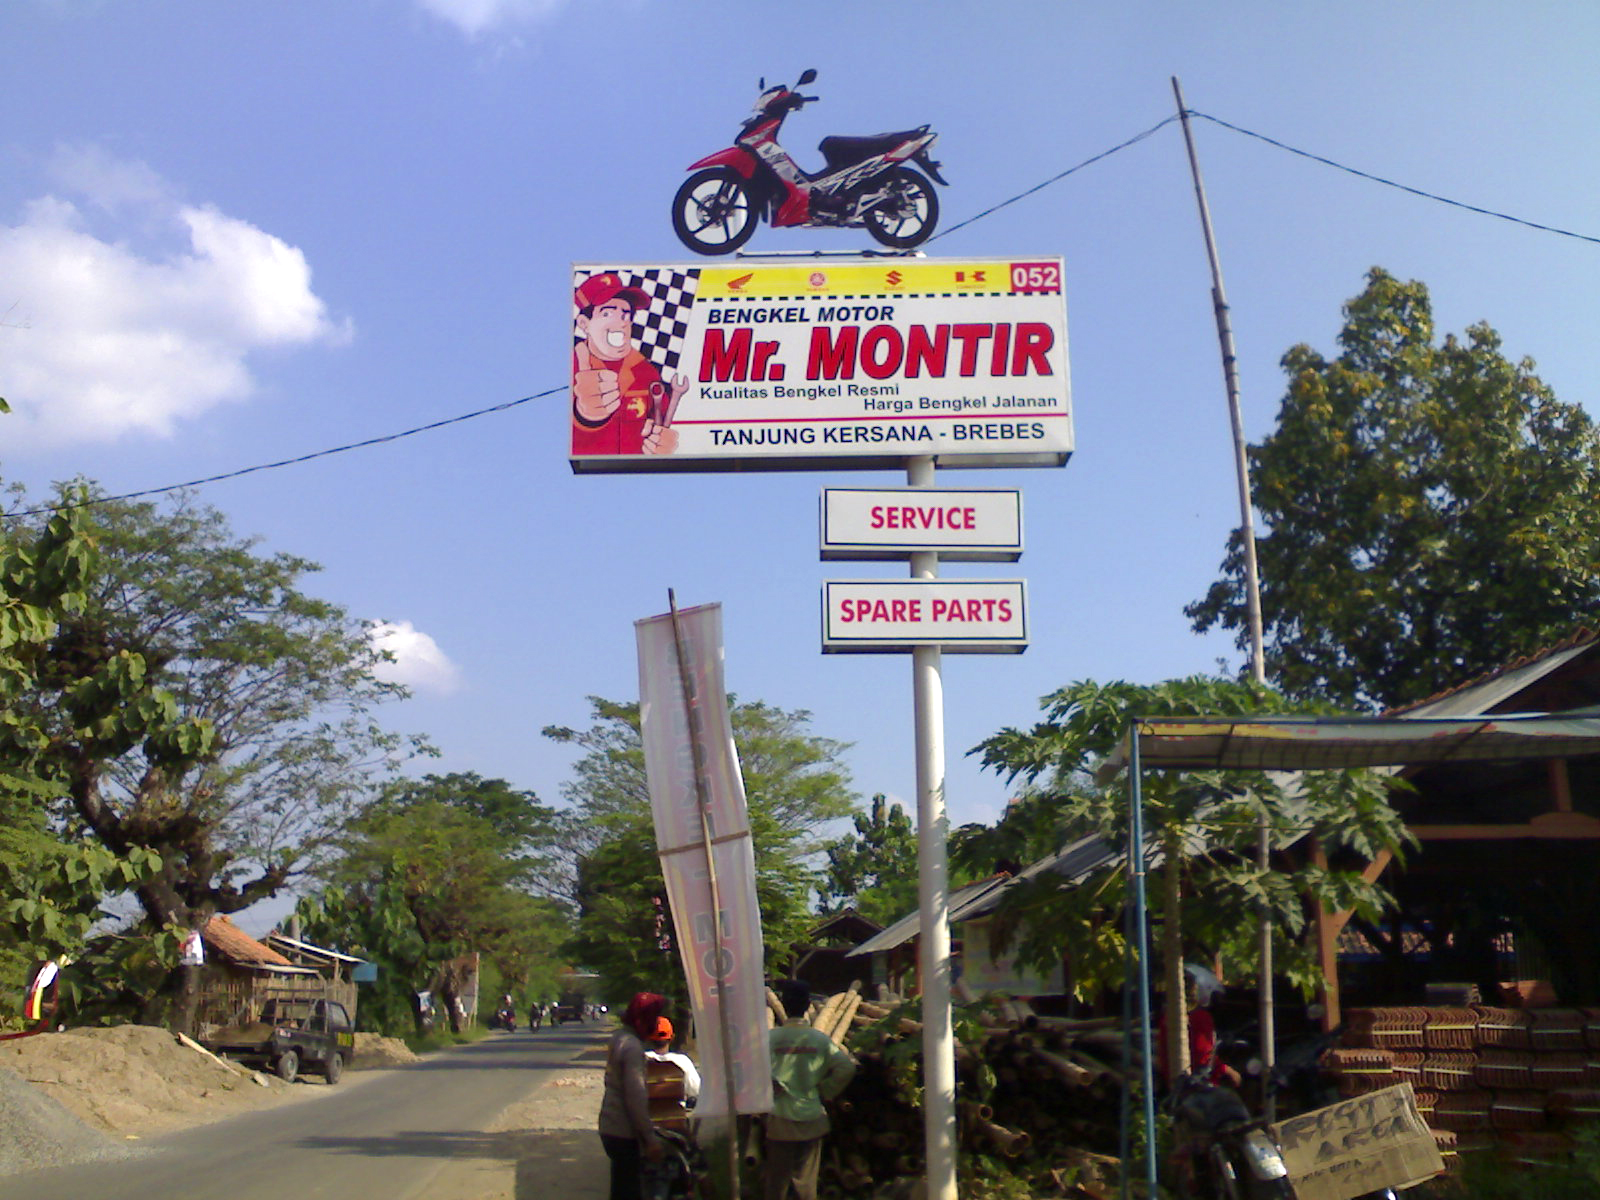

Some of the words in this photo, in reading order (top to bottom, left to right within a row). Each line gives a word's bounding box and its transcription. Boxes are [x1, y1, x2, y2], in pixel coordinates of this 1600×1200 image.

[1012, 267, 1058, 288] 052
[708, 307, 810, 324] BENGKEL
[817, 306, 895, 322] MOTOR
[698, 328, 786, 382] Mr.
[806, 322, 1055, 381] MONTIR
[700, 387, 768, 399] Kualitas
[774, 385, 841, 400] Bengkel
[847, 384, 900, 397] Resmi
[864, 398, 913, 412] Harga
[919, 396, 987, 411] Bengkel
[992, 396, 1057, 408] Jalanan
[709, 428, 815, 445] TANJUNG
[823, 425, 933, 443] KERSANA
[953, 423, 1045, 441] BREBES
[870, 506, 976, 529] SERVICE
[840, 599, 922, 622] SPARE
[932, 599, 1013, 622] PARTS
